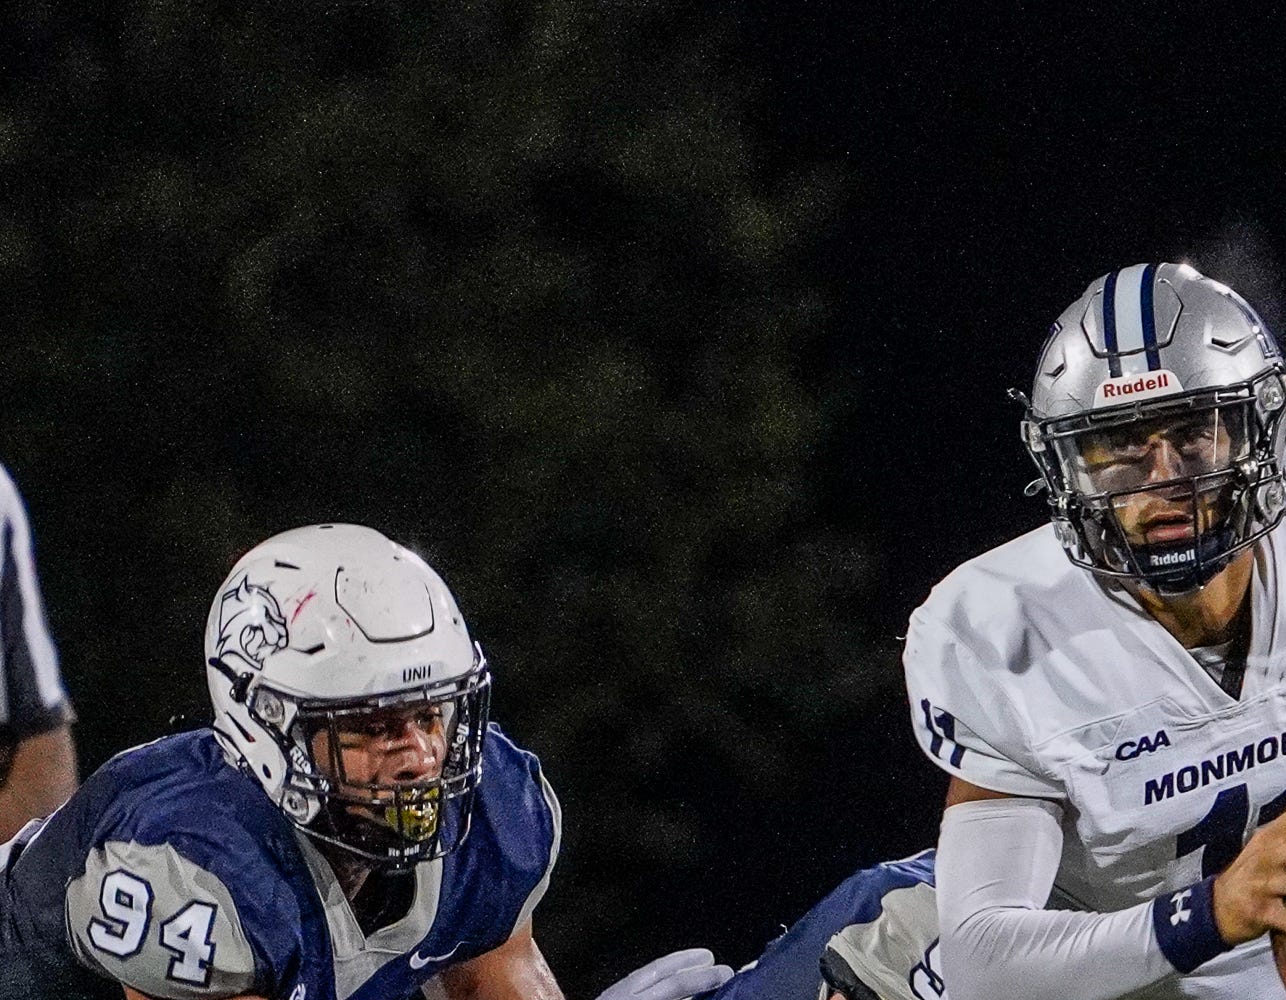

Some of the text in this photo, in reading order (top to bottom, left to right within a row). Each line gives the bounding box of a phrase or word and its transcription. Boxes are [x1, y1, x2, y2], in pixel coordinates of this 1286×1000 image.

[1150, 548, 1196, 566] Riddell
[920, 697, 966, 770] 11
[1115, 730, 1171, 761] CAA
[86, 868, 218, 988] 94
